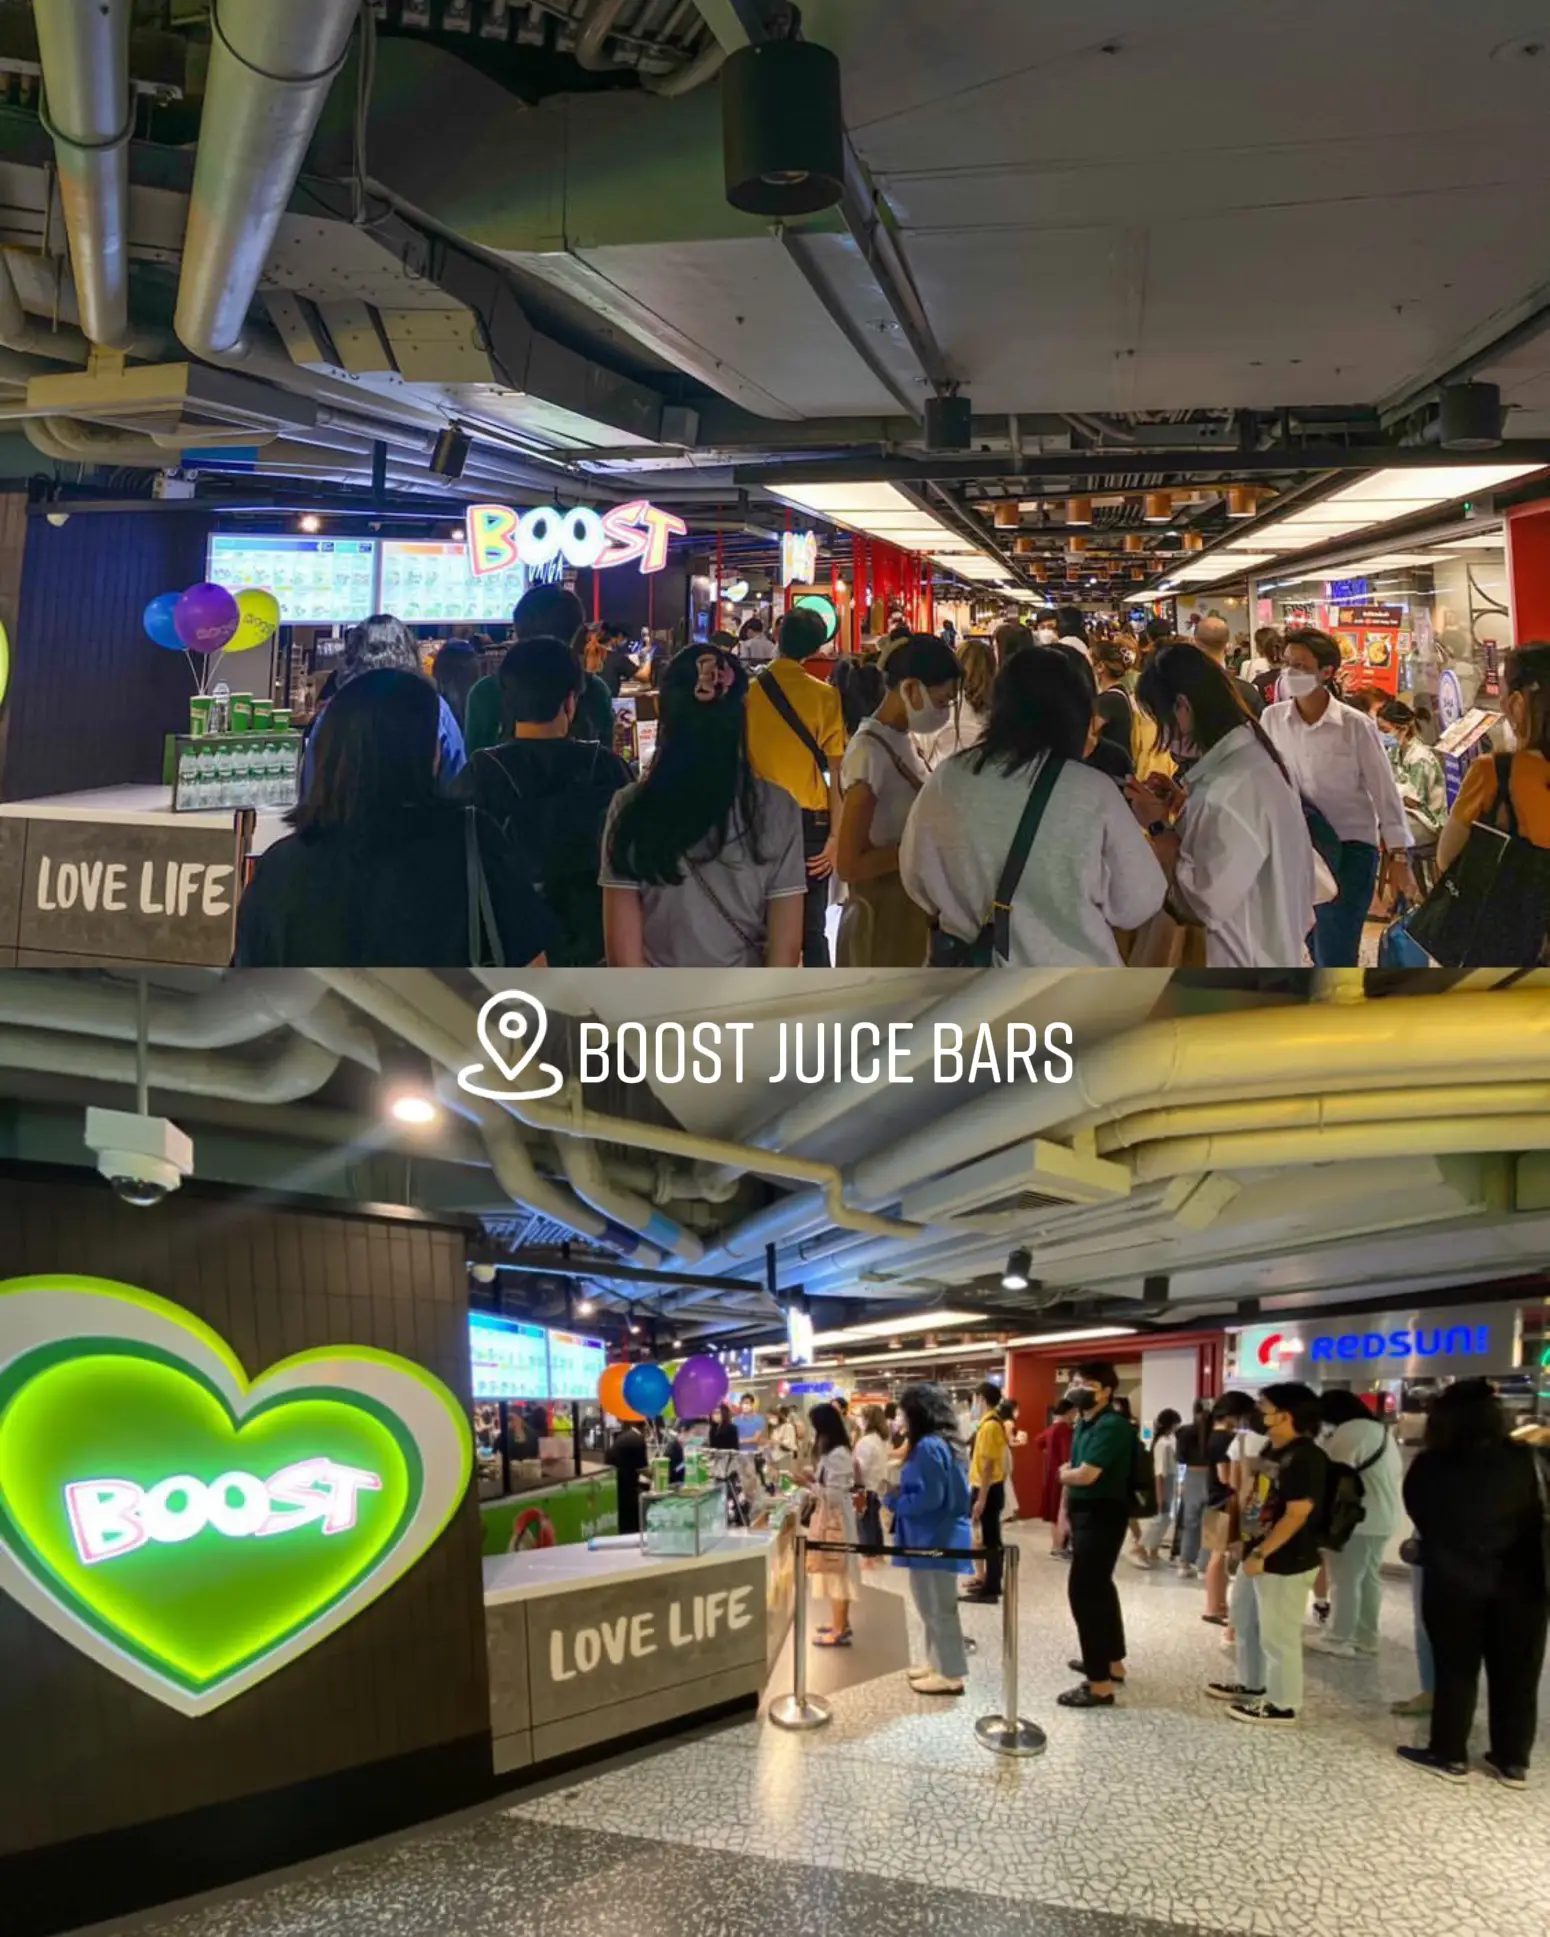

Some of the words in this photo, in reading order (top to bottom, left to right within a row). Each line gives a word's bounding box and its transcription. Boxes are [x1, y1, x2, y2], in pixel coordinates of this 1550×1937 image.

[467, 499, 687, 577] BOOST
[37, 855, 128, 911] LOVE
[140, 861, 234, 917] LIFE
[65, 1457, 382, 1564] BOOST
[550, 1612, 658, 1682] LOVE
[669, 1585, 753, 1647] LIFE
